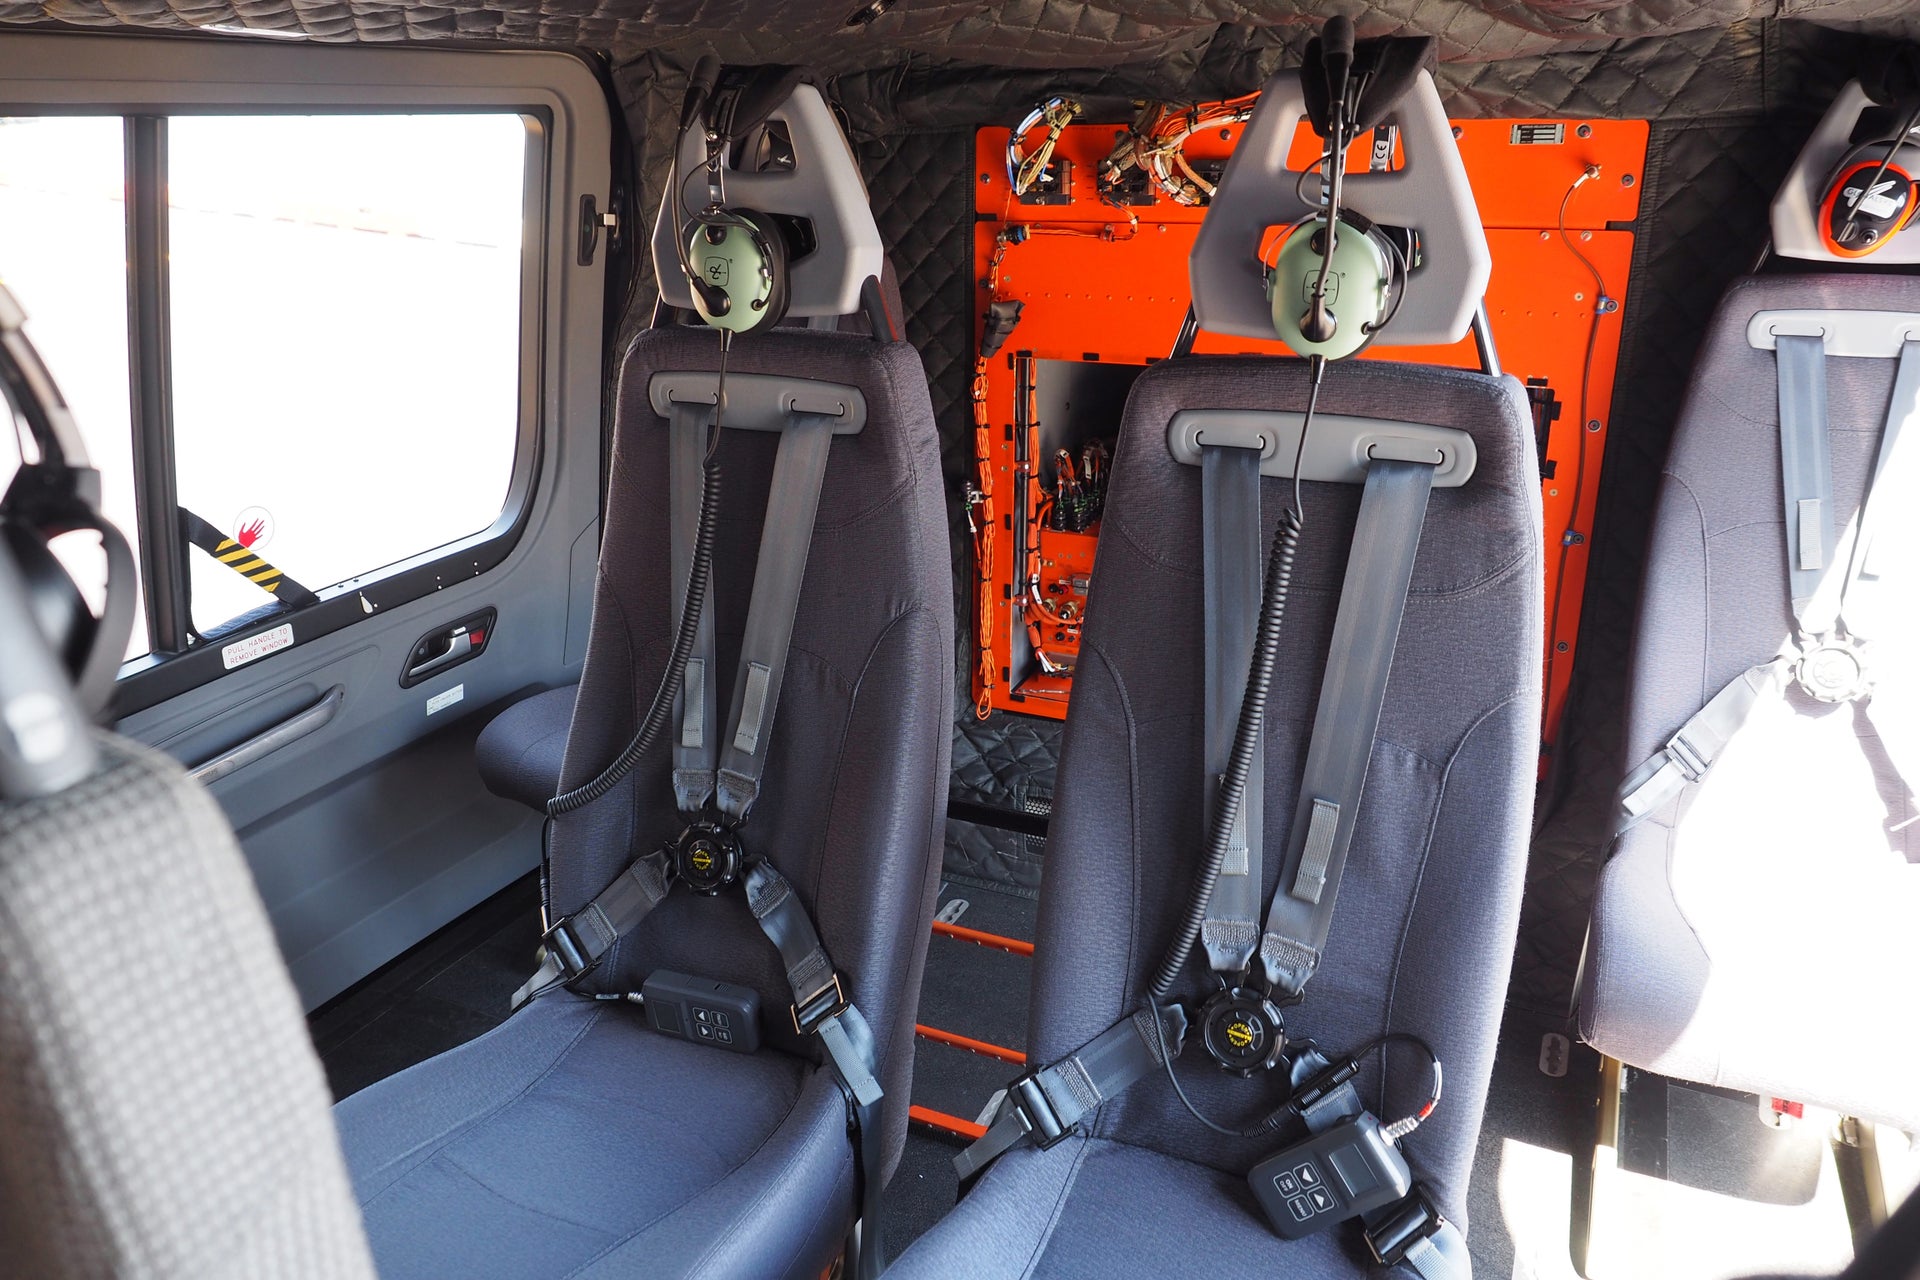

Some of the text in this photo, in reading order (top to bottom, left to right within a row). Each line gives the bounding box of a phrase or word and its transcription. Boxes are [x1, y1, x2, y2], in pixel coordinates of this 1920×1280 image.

[227, 627, 288, 655] PULL HANDLE TO
[230, 638, 288, 665] REMOVE WINDOW
[1279, 1180, 1289, 1191] OFF
[1285, 1179, 1294, 1189] ON
[1294, 1199, 1307, 1217] MENU
